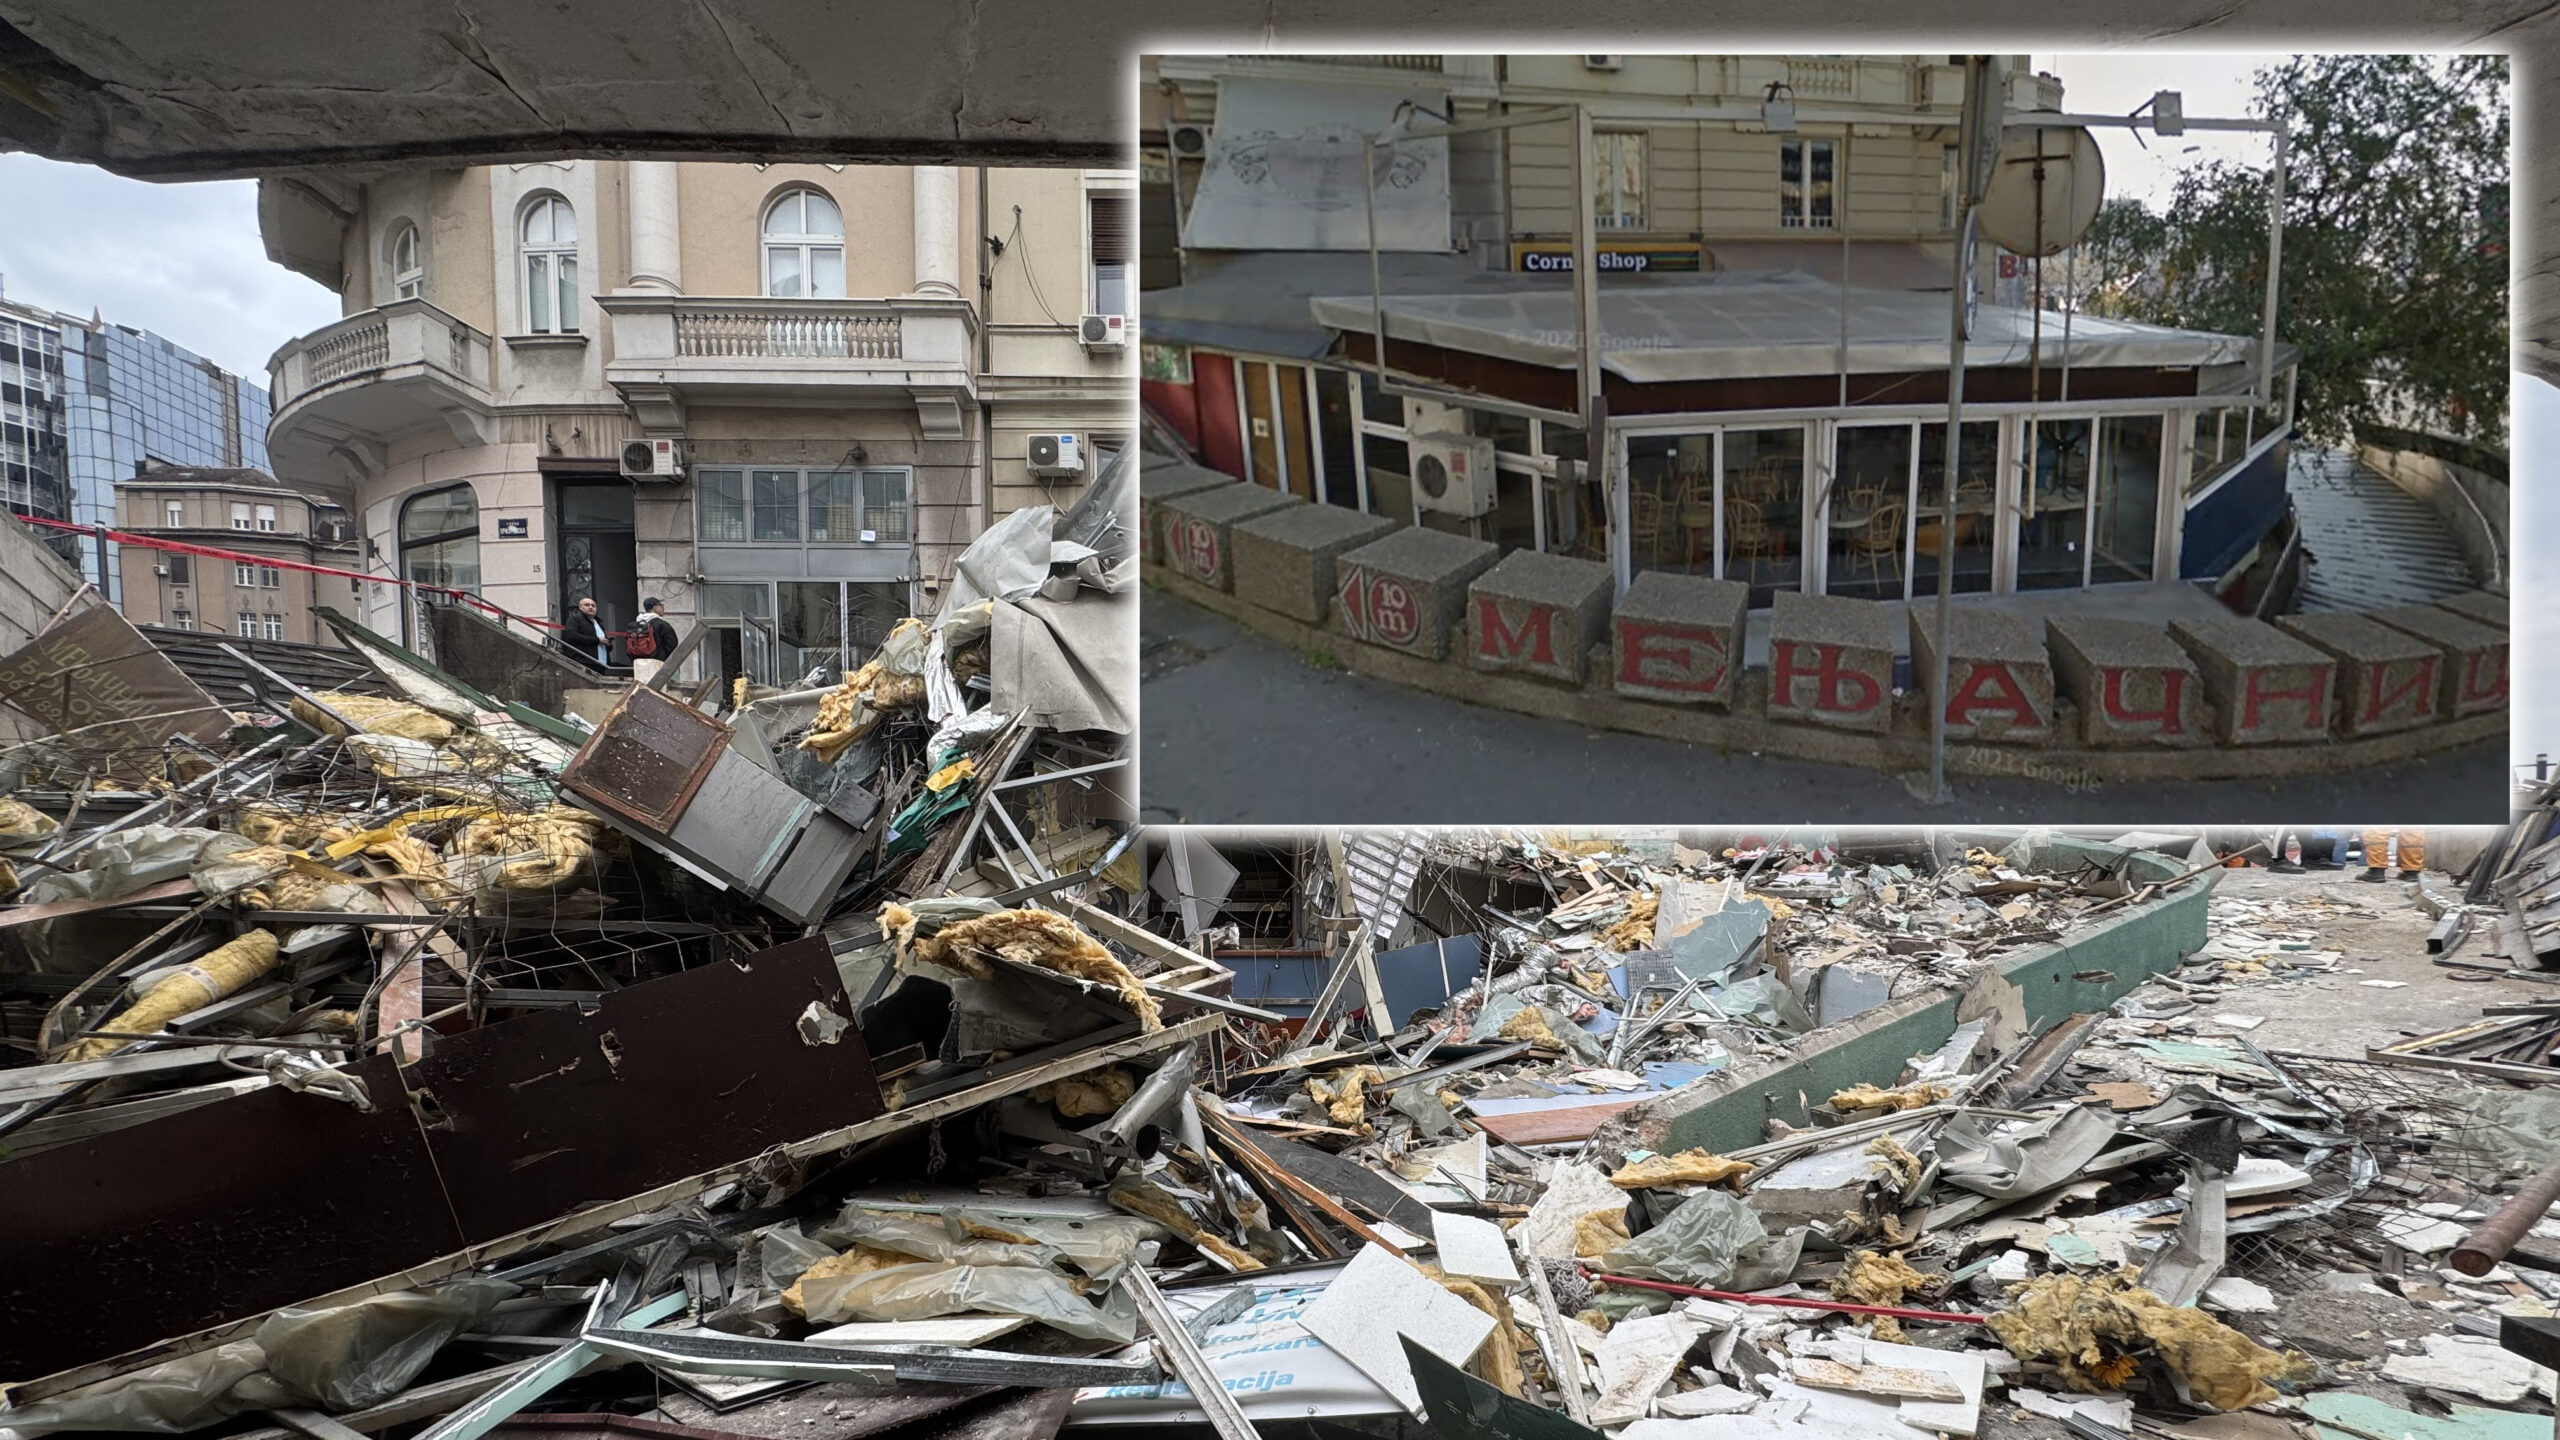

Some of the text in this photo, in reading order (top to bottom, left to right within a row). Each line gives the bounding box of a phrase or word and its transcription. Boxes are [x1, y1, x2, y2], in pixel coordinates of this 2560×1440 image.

[1526, 252, 1647, 272] Corn Shop
[533, 564, 541, 573] 15
[1379, 582, 1407, 610] 10
[1377, 608, 1408, 634] m
[1105, 1371, 1295, 1399] Regisacija
